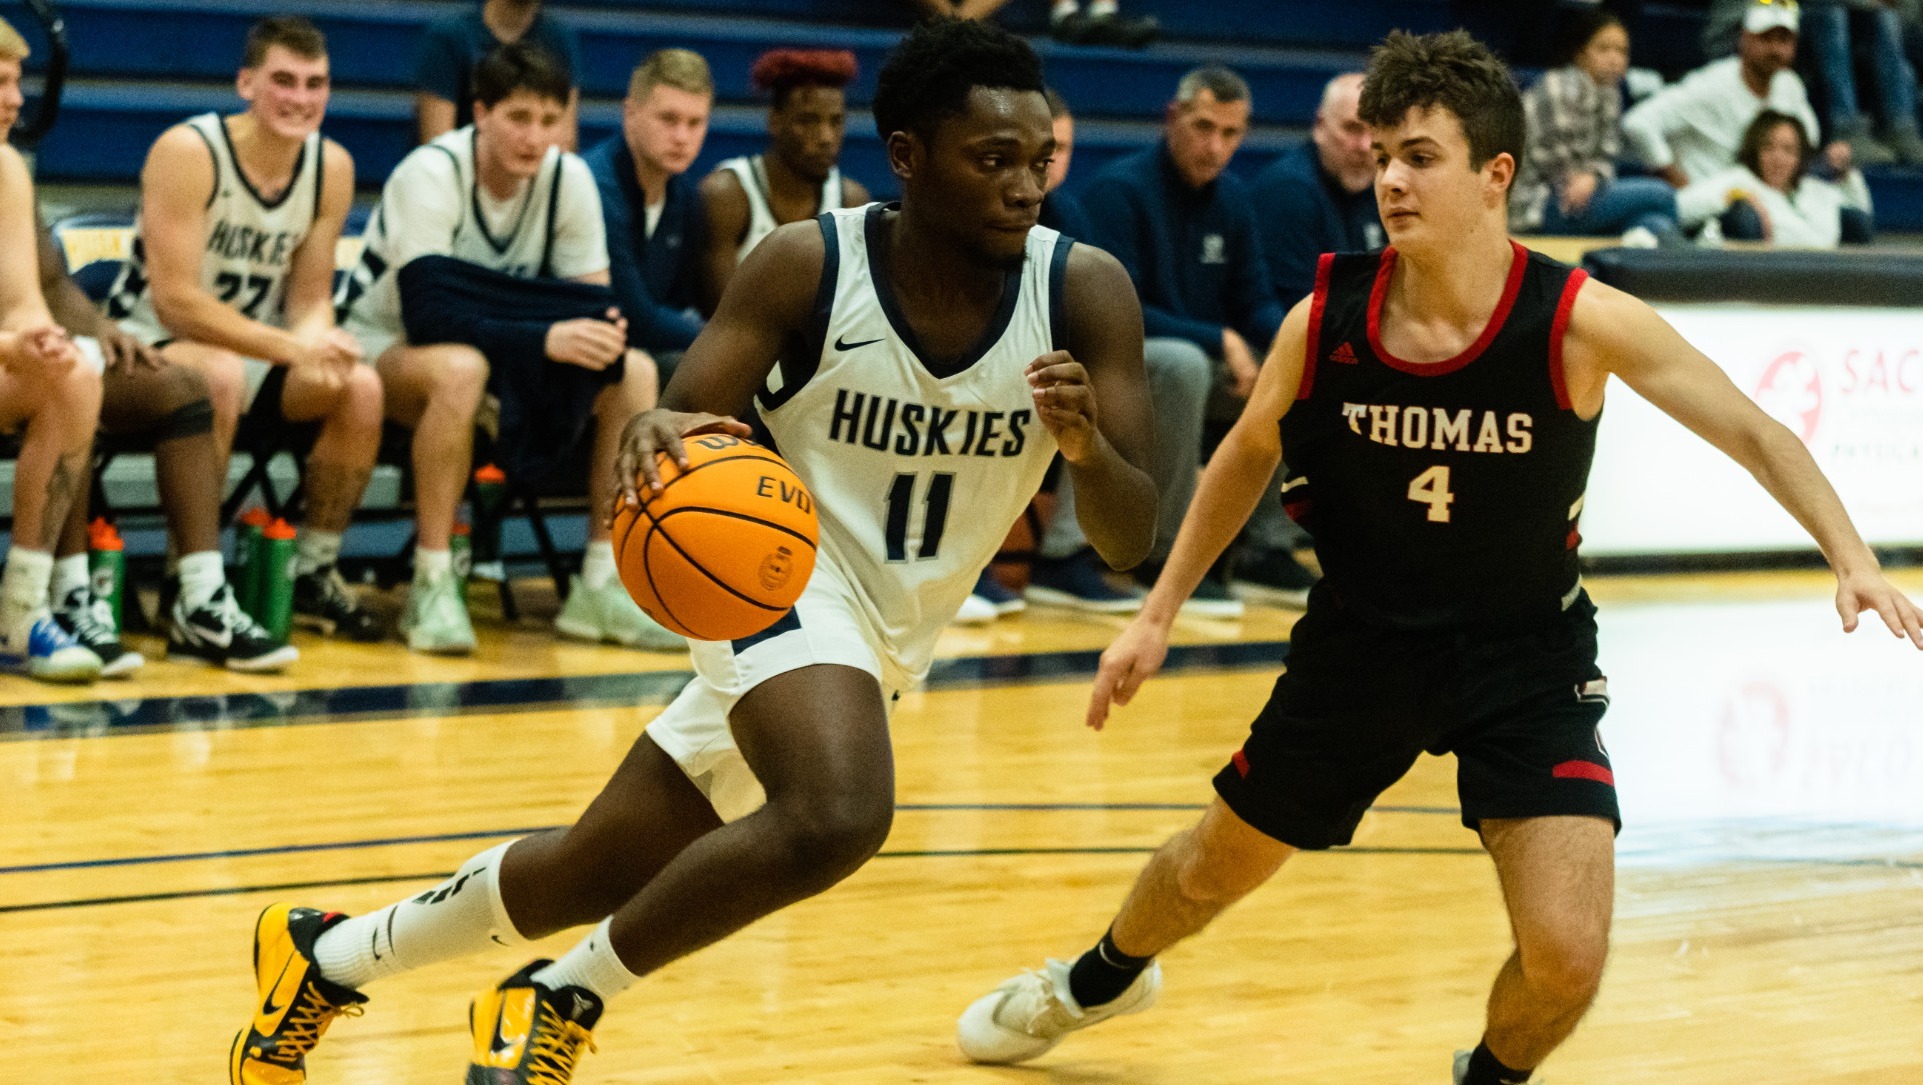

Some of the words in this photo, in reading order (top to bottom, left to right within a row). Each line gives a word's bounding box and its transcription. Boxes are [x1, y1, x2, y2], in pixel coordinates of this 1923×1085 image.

[1840, 348, 1920, 394] SAC
[828, 386, 1032, 458] HUSKIES
[1341, 402, 1534, 454] THOMAS
[756, 475, 811, 515] EVO
[882, 469, 957, 565] 11
[1406, 464, 1455, 524] 4
